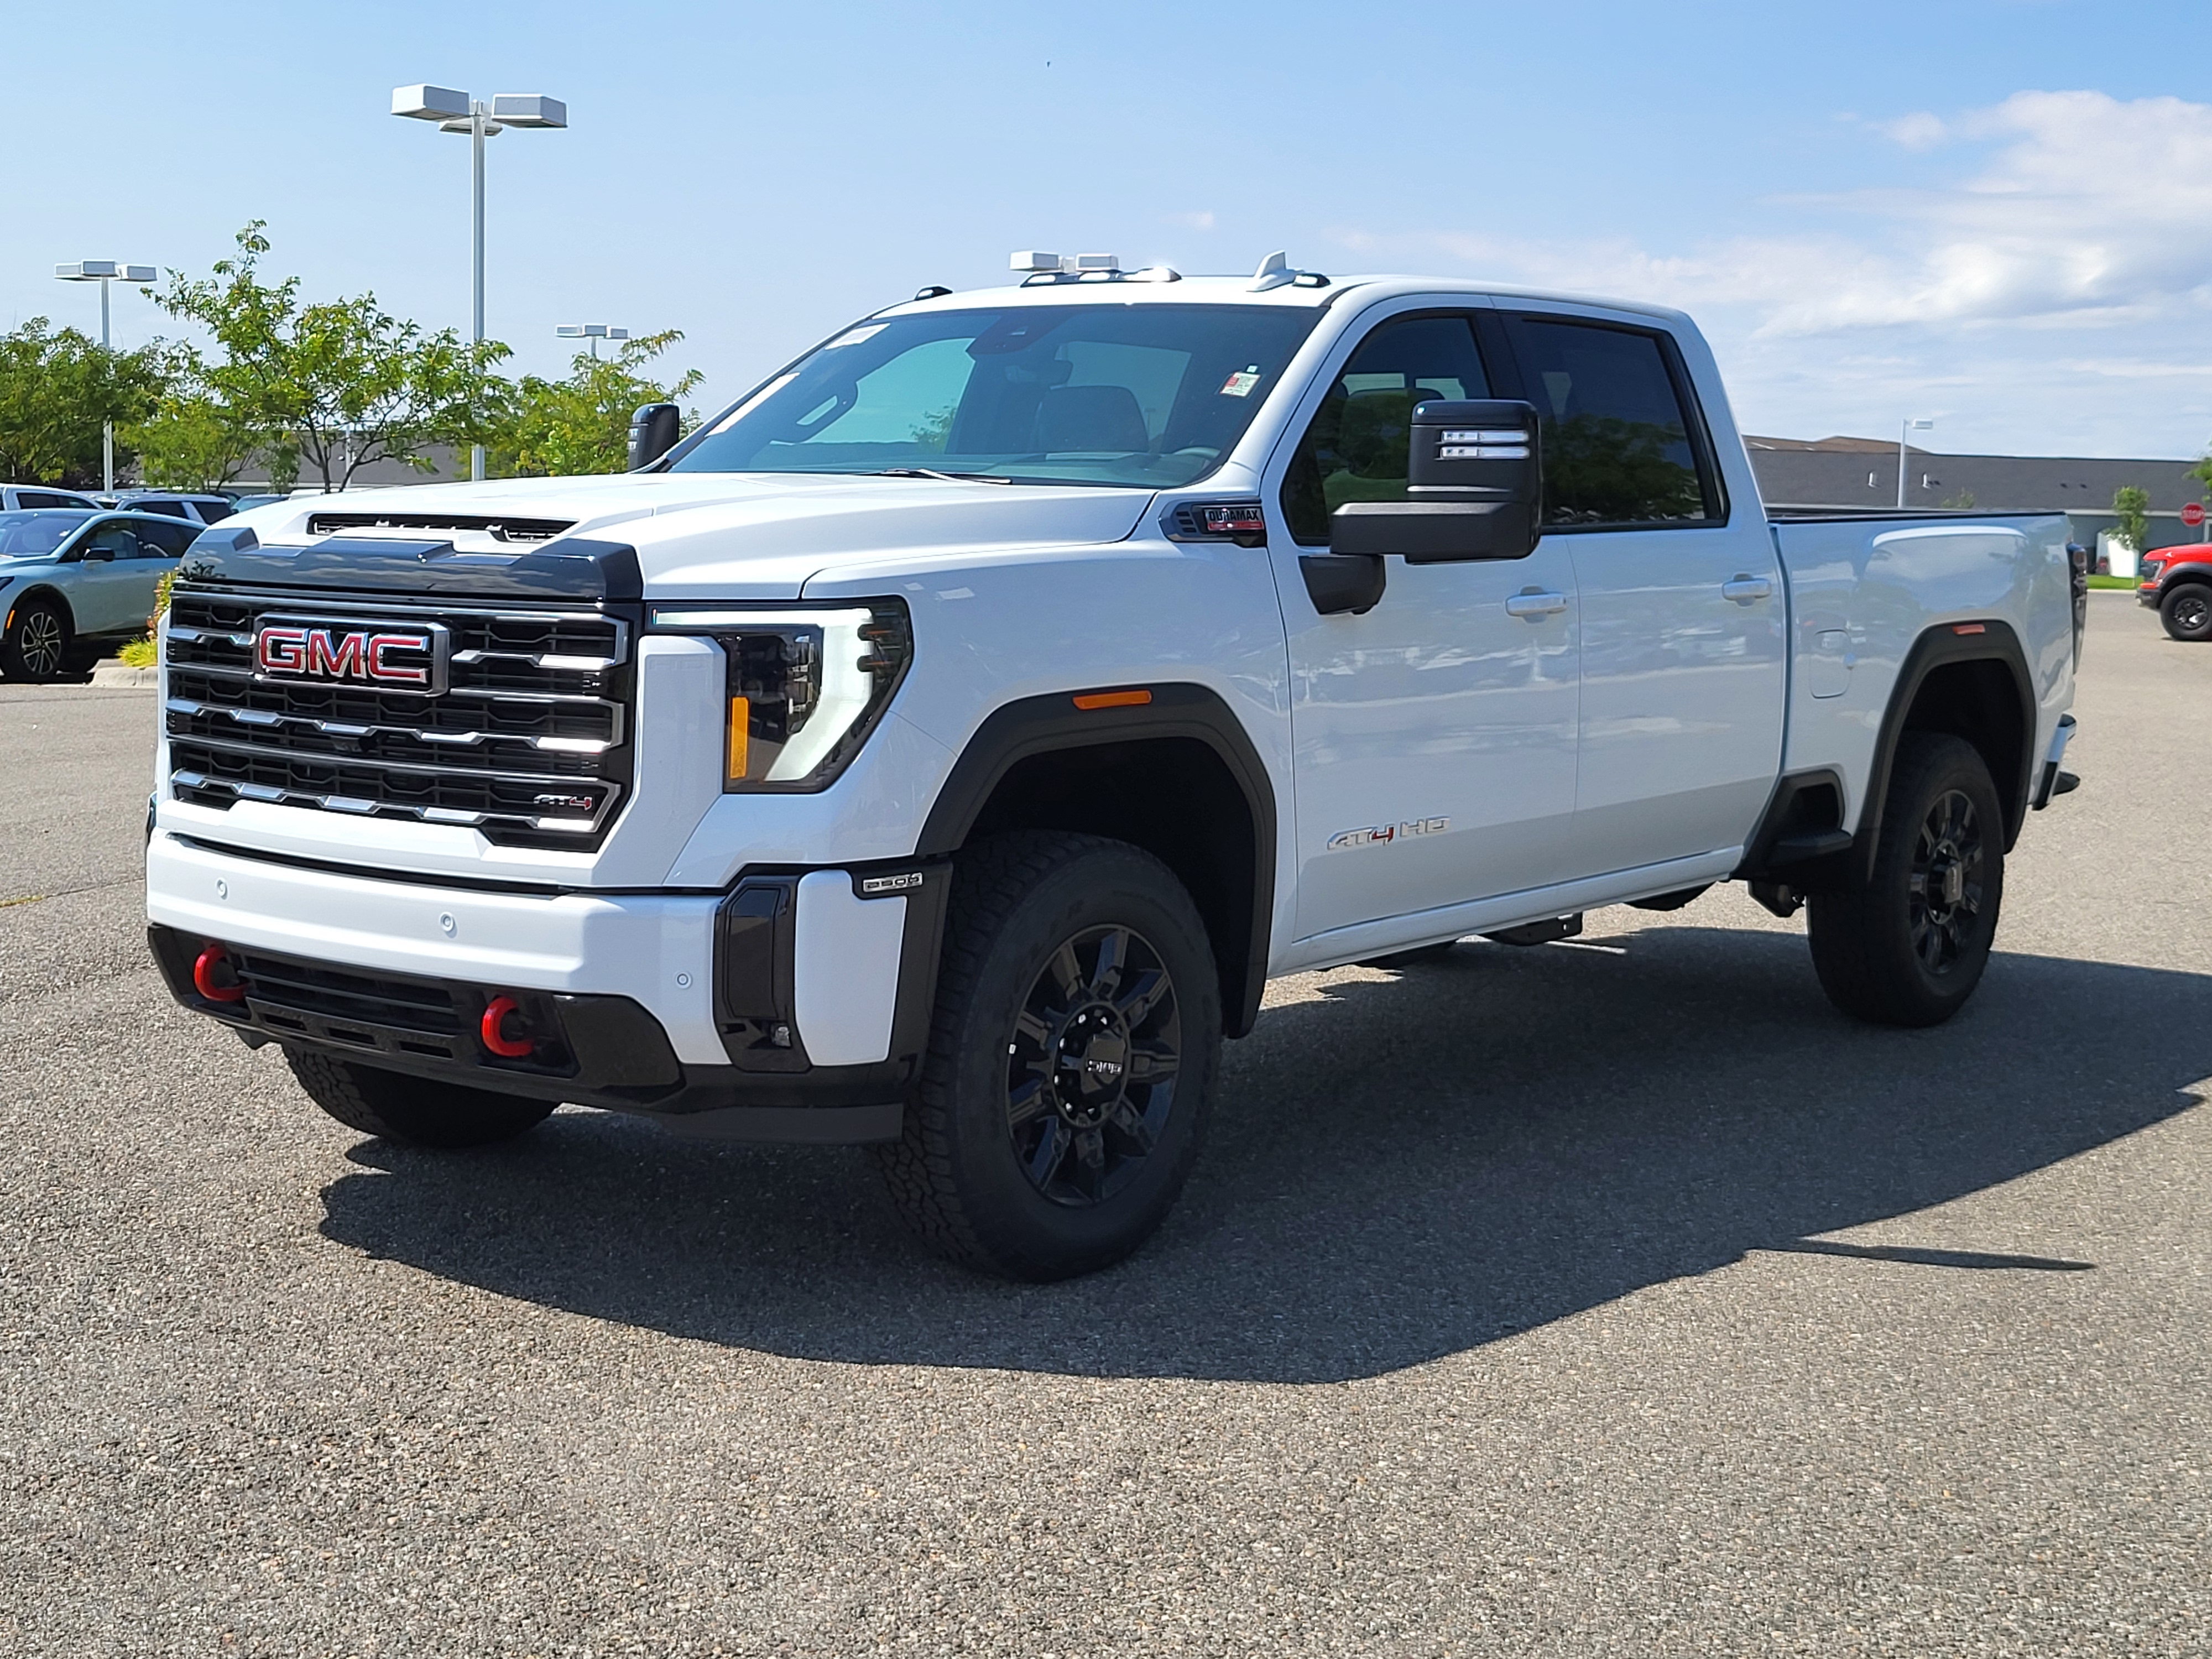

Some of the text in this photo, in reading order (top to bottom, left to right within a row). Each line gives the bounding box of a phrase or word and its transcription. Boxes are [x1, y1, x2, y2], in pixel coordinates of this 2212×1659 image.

[1208, 509, 1259, 521] DURAMAX
[2182, 509, 2204, 519] STOP
[259, 627, 430, 684] GMC
[533, 794, 592, 811] AT4
[1327, 816, 1450, 850] AT4 HD
[864, 873, 922, 892] 2500
